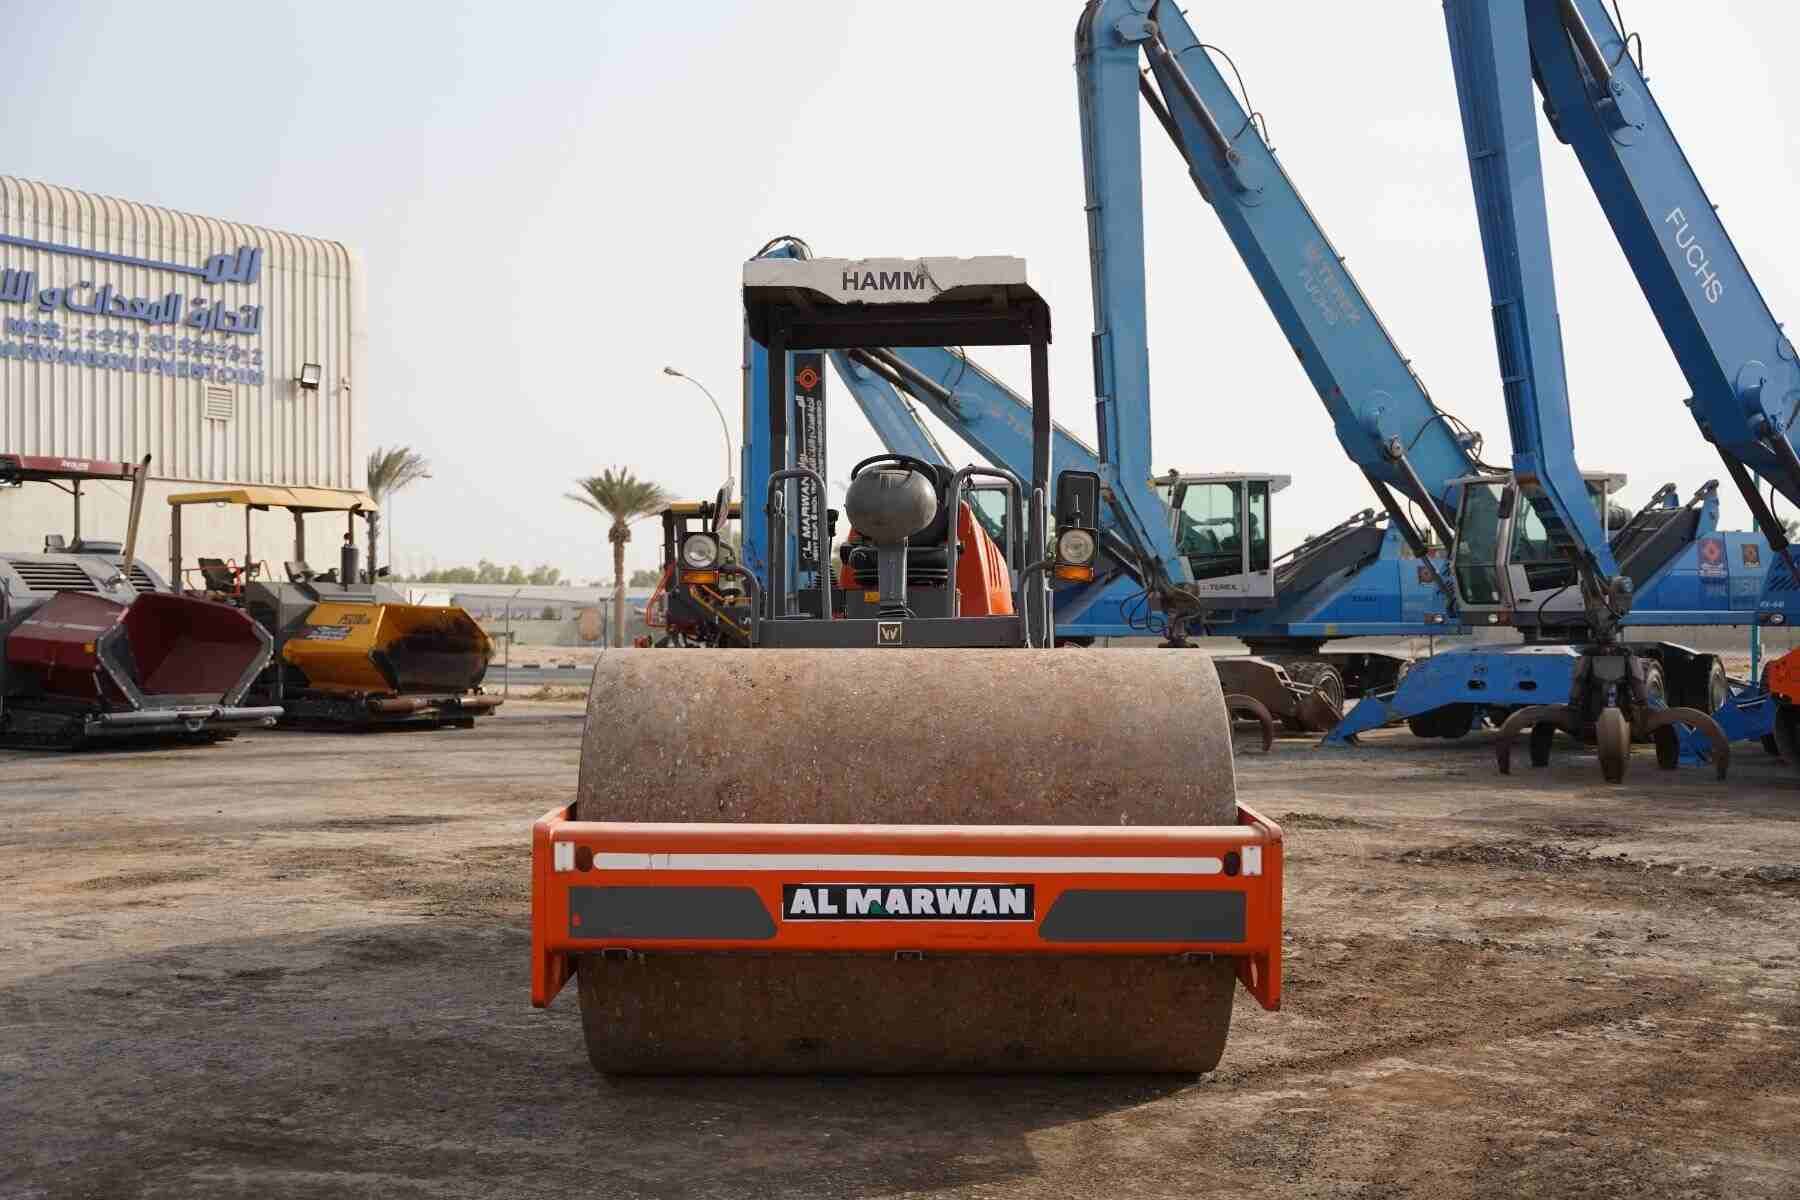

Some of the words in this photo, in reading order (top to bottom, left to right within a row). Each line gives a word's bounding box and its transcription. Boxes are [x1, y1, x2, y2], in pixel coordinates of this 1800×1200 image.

[1665, 208, 1723, 303] FUCHS
[842, 271, 926, 291] HAMM
[800, 476, 811, 538] MARWAN
[790, 888, 837, 914] AL
[846, 888, 1026, 914] MARWAN
